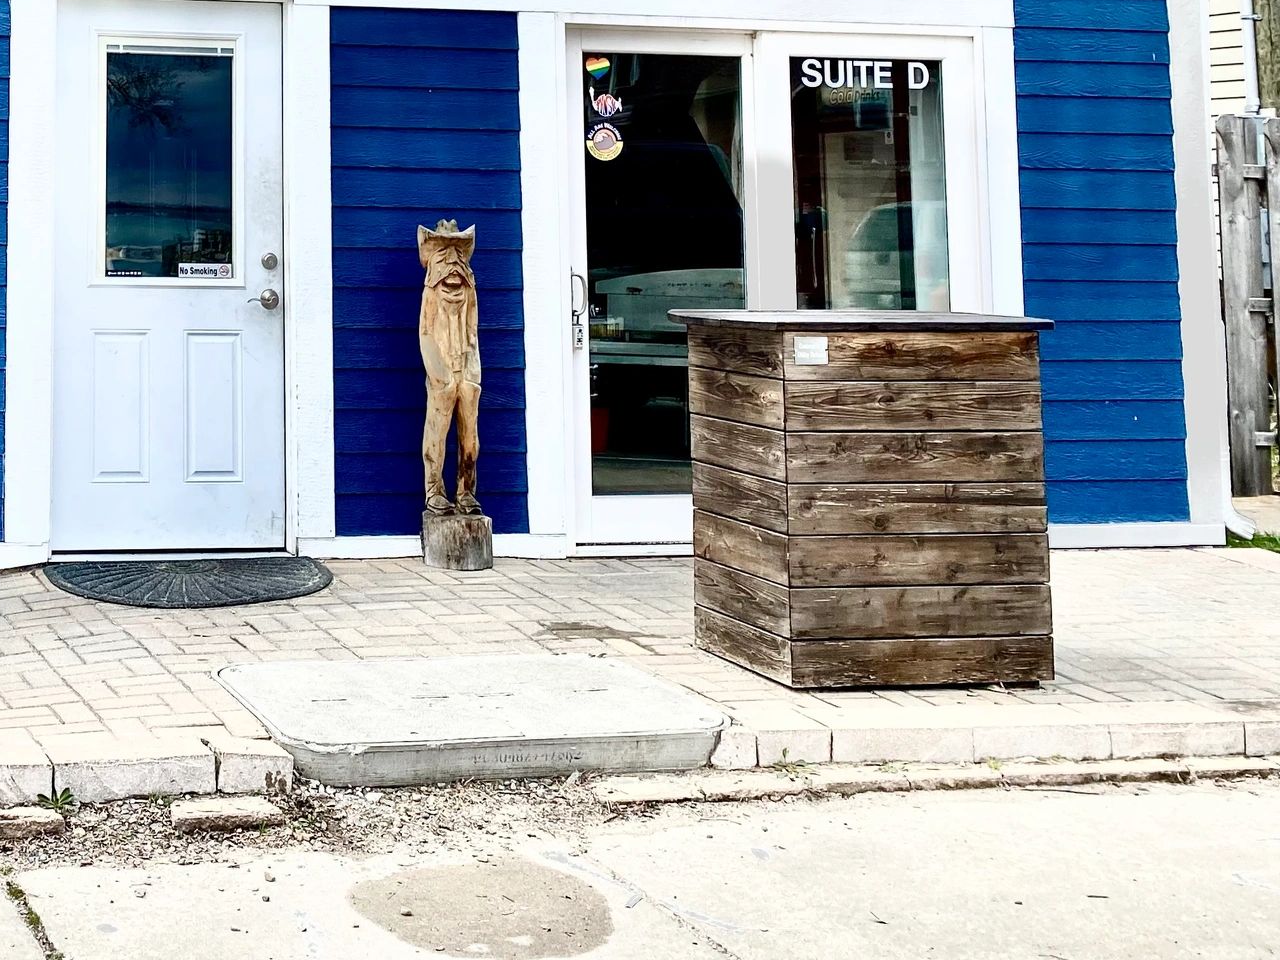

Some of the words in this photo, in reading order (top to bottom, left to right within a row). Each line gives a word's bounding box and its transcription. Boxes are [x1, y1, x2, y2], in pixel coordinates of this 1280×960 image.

[801, 59, 894, 89] SUITE
[908, 61, 930, 90] D
[830, 88, 853, 104] Cold
[853, 89, 881, 103] Drinks
[180, 267, 189, 275] No
[190, 266, 218, 276] Smoking
